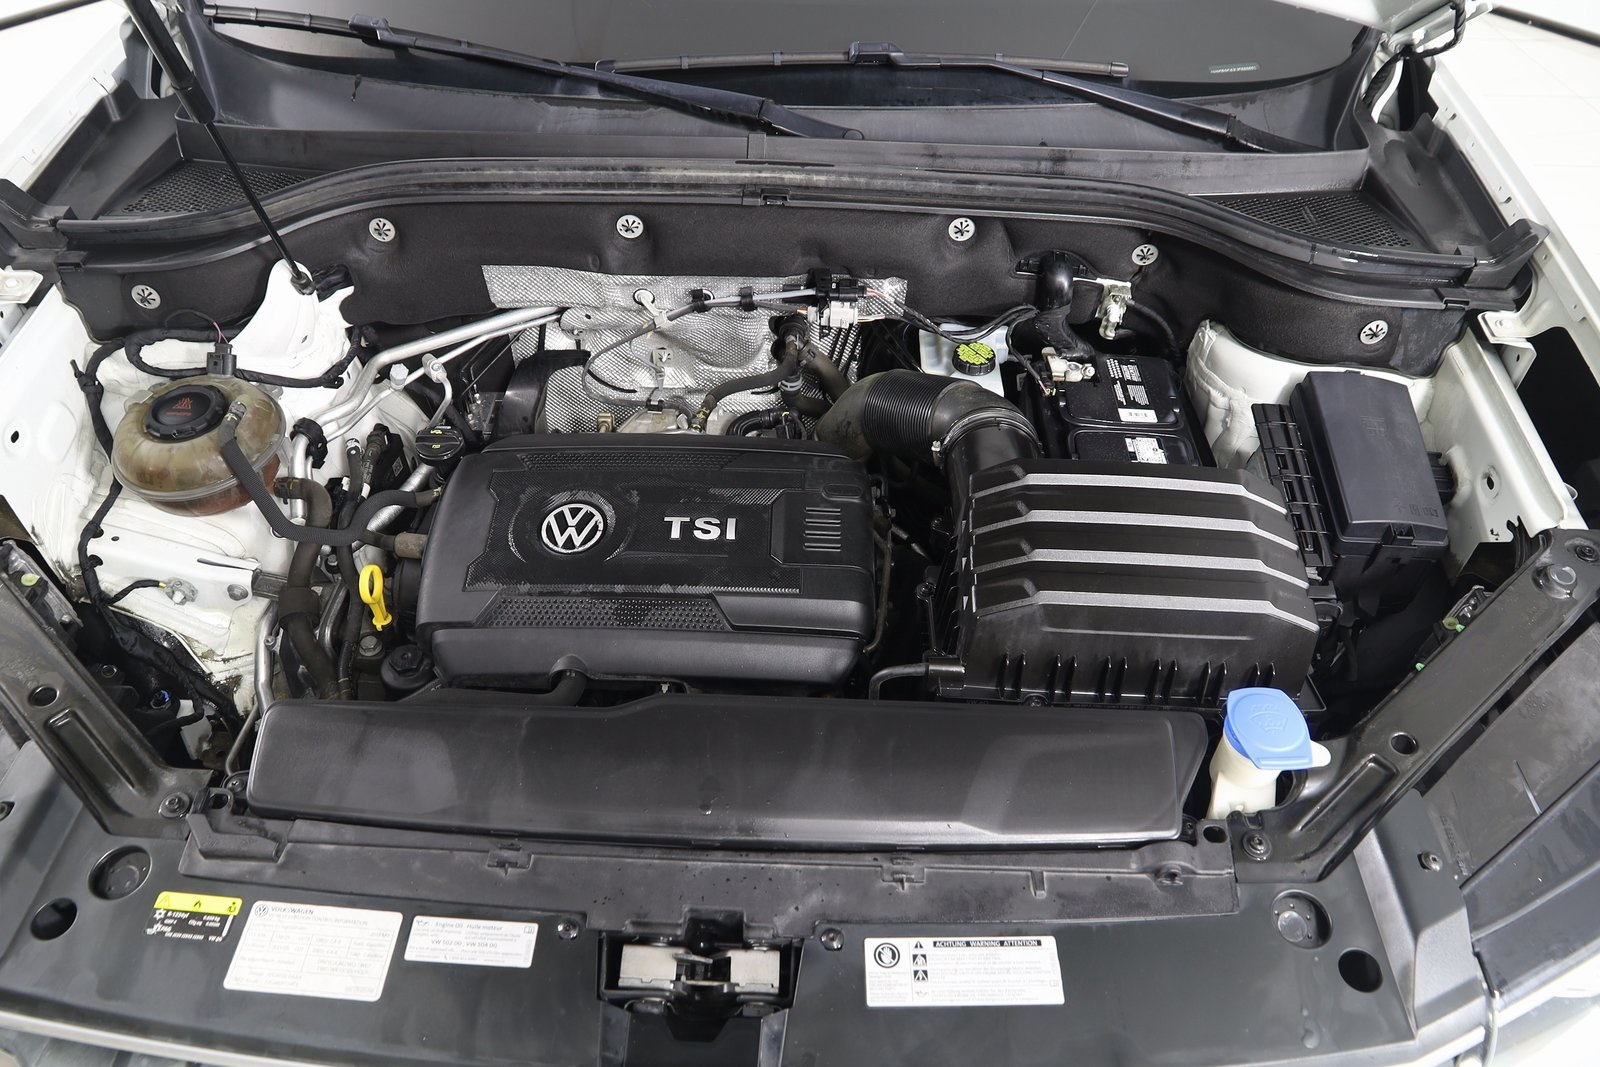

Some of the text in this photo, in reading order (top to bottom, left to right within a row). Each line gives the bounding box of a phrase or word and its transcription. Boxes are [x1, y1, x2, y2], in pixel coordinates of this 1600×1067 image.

[664, 516, 737, 540] TSI
[271, 905, 314, 915] VOLKSWAGEN
[435, 921, 454, 929] Engine
[935, 939, 1038, 948] ACHTUNG WARNING ATTENTION
